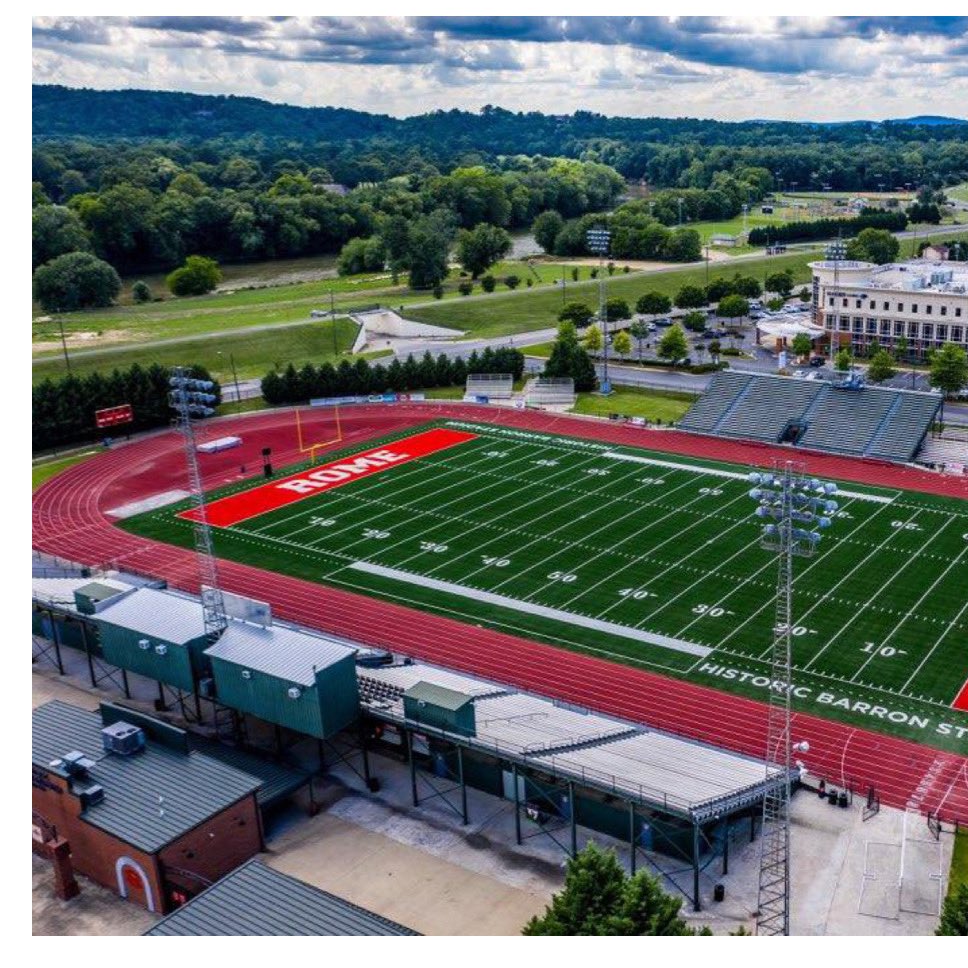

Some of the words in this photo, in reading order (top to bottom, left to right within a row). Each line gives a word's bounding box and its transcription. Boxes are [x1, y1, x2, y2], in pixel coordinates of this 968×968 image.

[276, 449, 411, 493] ROME
[547, 570, 578, 583] 50
[618, 587, 648, 600] 40
[692, 603, 725, 618] 30
[860, 641, 897, 657] 10
[700, 662, 813, 700] HISTORIC
[816, 692, 929, 729] BARRON
